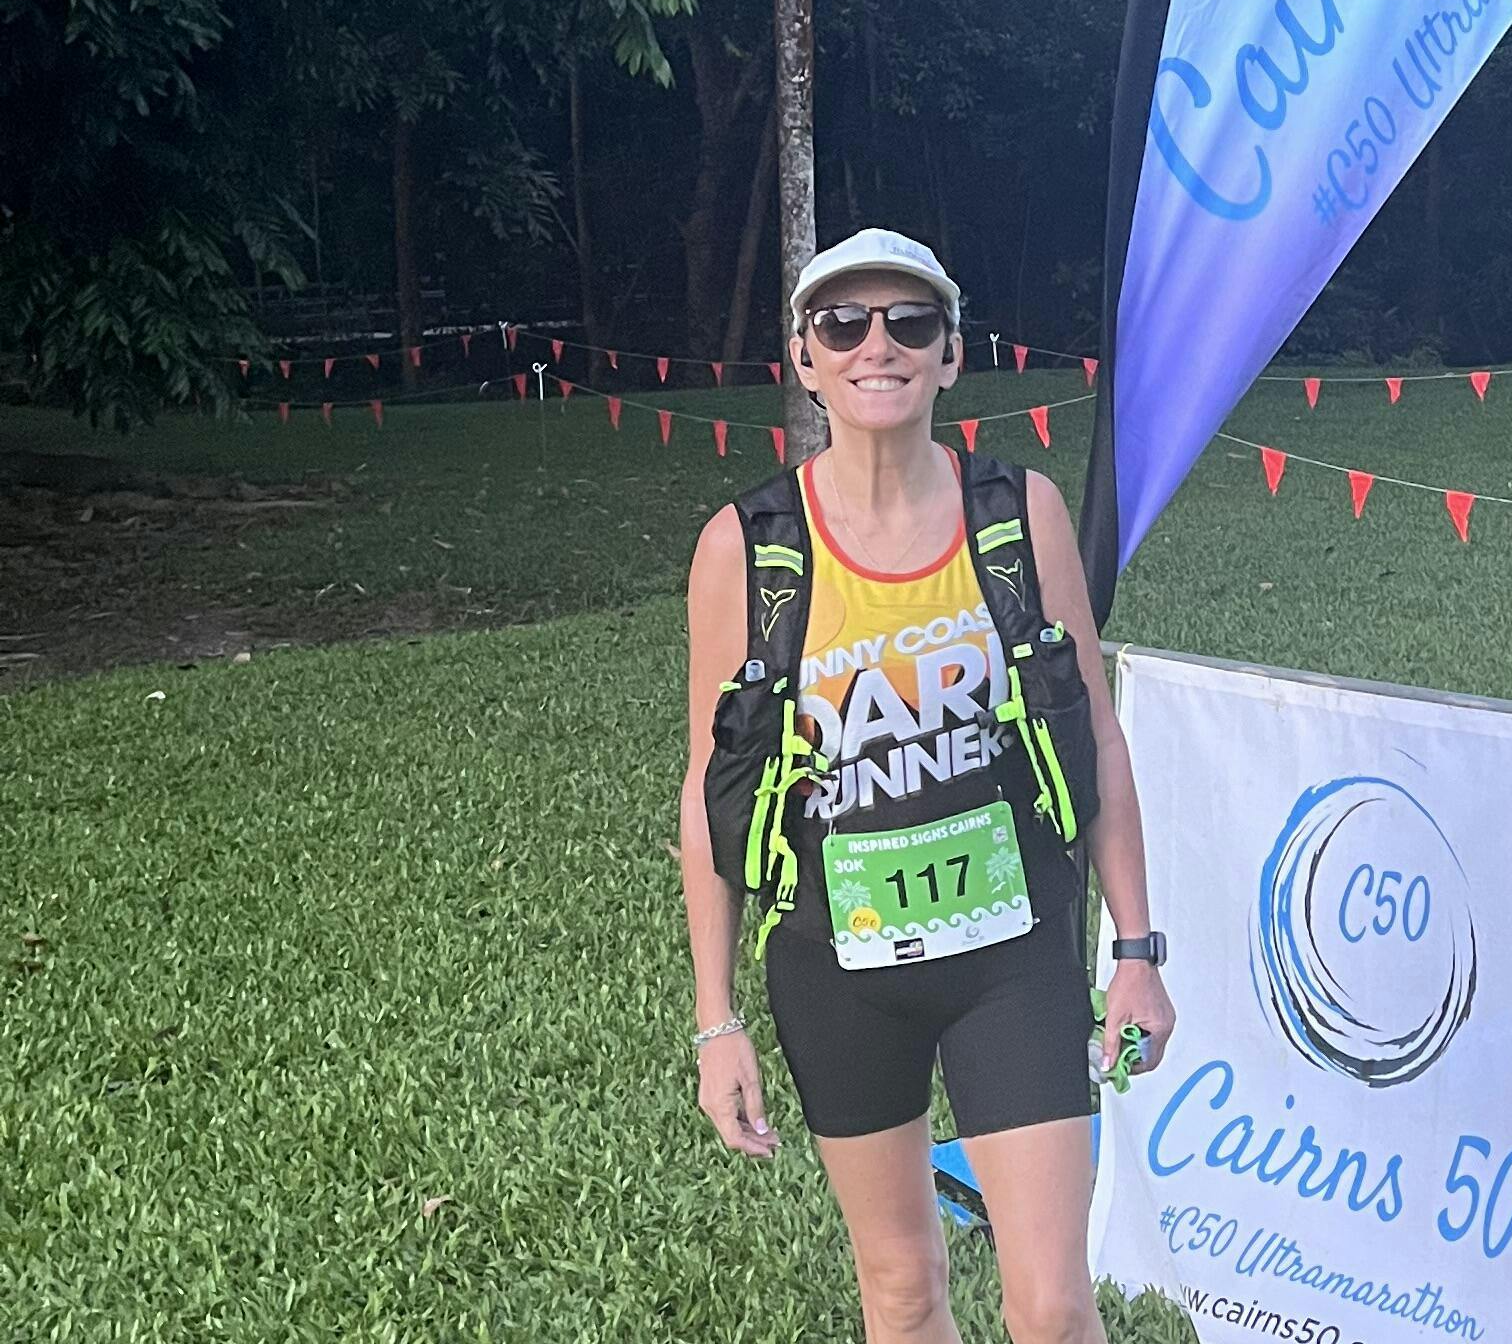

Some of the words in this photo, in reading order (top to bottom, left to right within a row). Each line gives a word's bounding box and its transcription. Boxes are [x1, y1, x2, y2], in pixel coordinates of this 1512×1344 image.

[1312, 95, 1397, 226] #C50
[894, 602, 995, 654] COAS
[834, 859, 867, 874] 30K
[848, 836, 909, 854] INSPIRED
[911, 826, 948, 845] SIGNS
[949, 813, 992, 834] CAIRNS
[885, 854, 970, 909] 117
[1338, 863, 1430, 943] C50
[1147, 1060, 1404, 1223] Cairns
[1160, 1206, 1239, 1257] #C50
[1236, 1228, 1485, 1342] Ultramarathon
